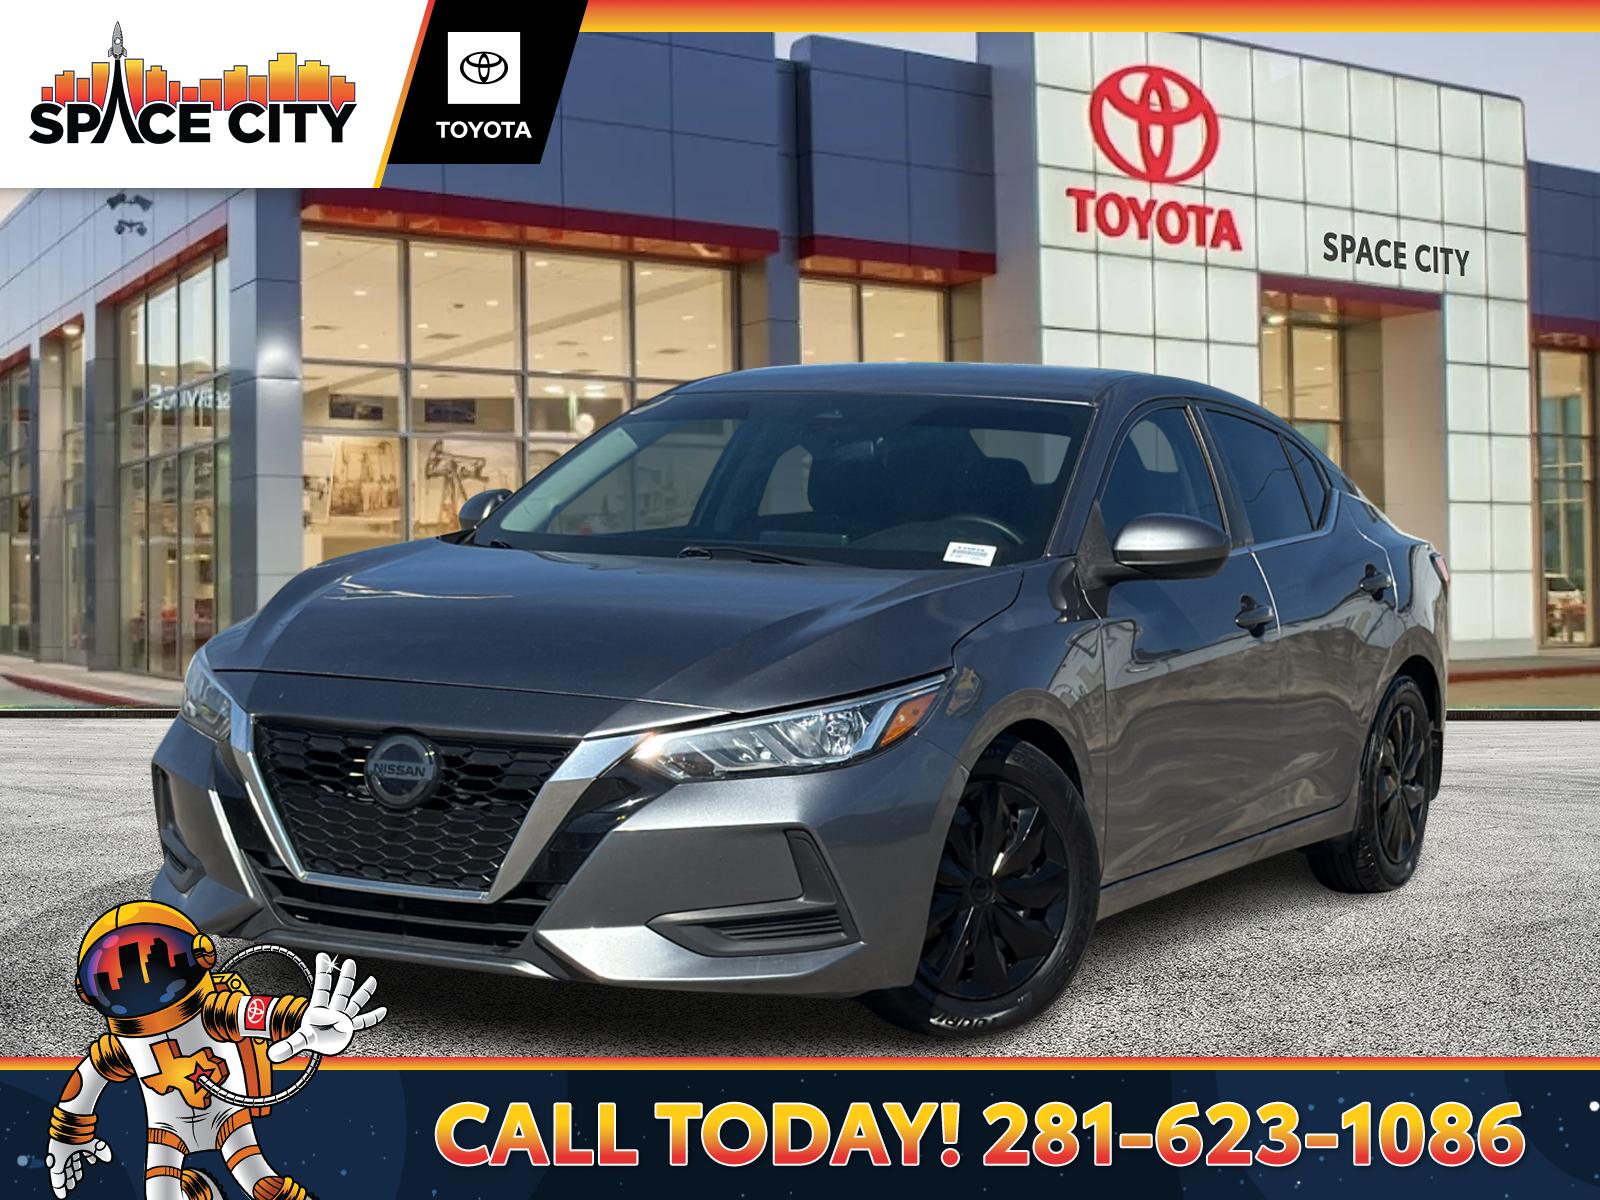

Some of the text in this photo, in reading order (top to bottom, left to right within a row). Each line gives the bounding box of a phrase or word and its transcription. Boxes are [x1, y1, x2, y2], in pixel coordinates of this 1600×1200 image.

[1066, 187, 1243, 251] TOYOTA
[1323, 232, 1470, 277] SPACE CITY
[373, 762, 426, 777] NISSAN
